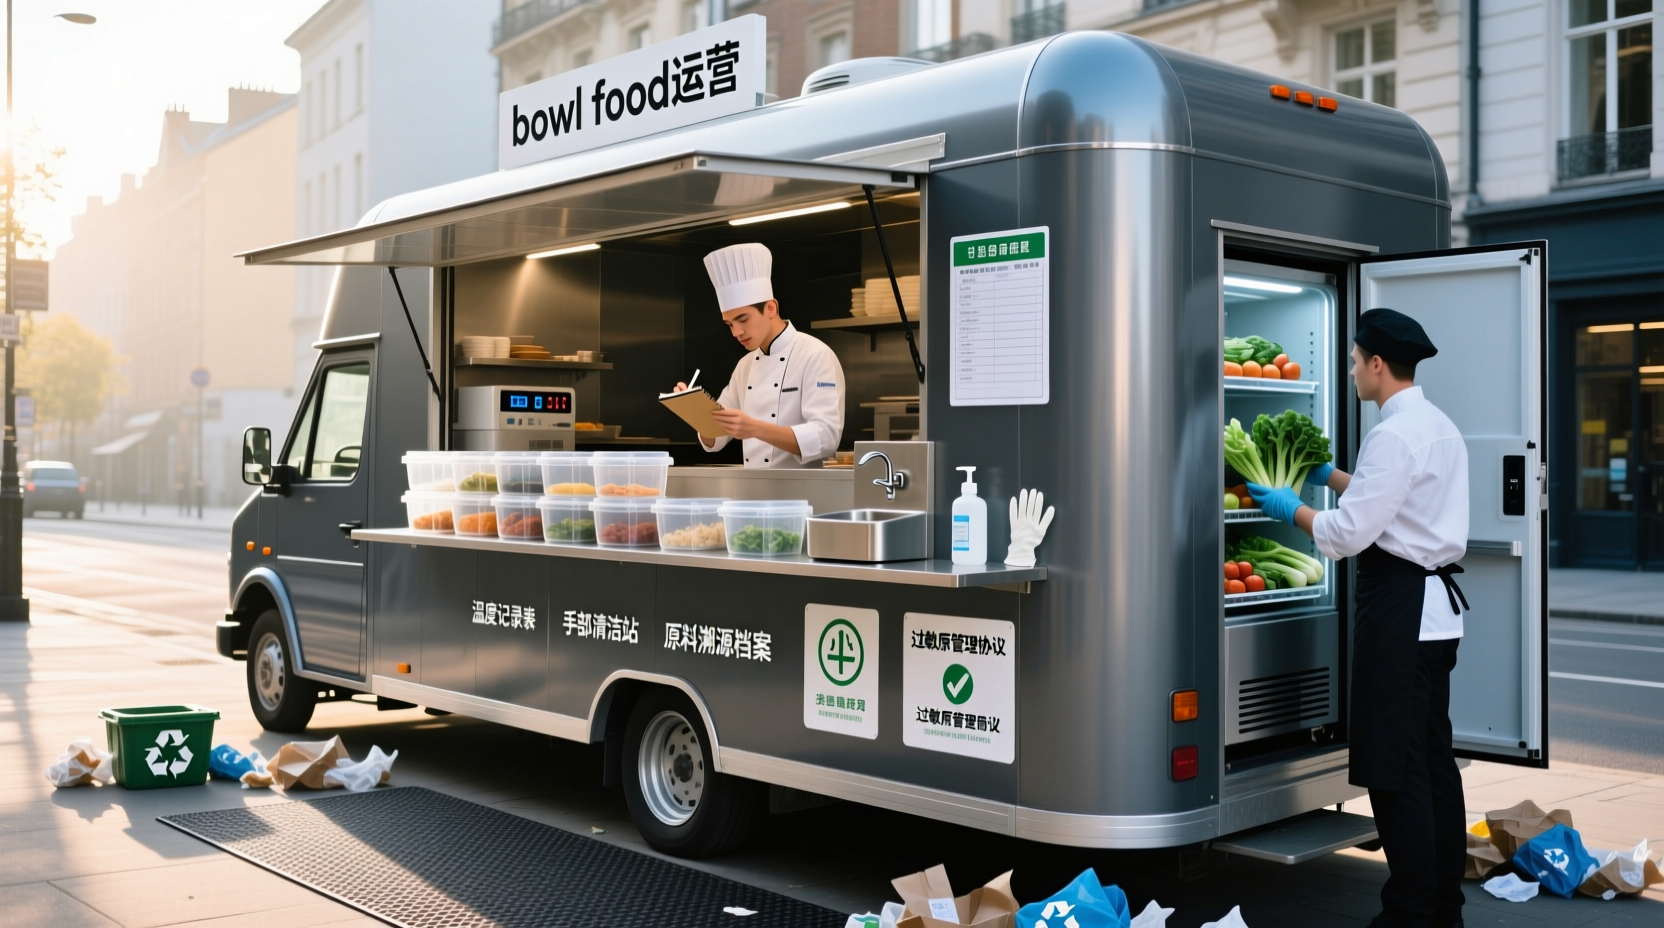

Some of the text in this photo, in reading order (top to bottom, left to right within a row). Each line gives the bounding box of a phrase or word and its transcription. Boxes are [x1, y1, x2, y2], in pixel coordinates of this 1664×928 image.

[512, 85, 582, 147] bowl
[472, 599, 536, 631] 温度记录表
[562, 610, 640, 644] 手部清洁站
[911, 629, 1006, 656] 过敏原管理协议
